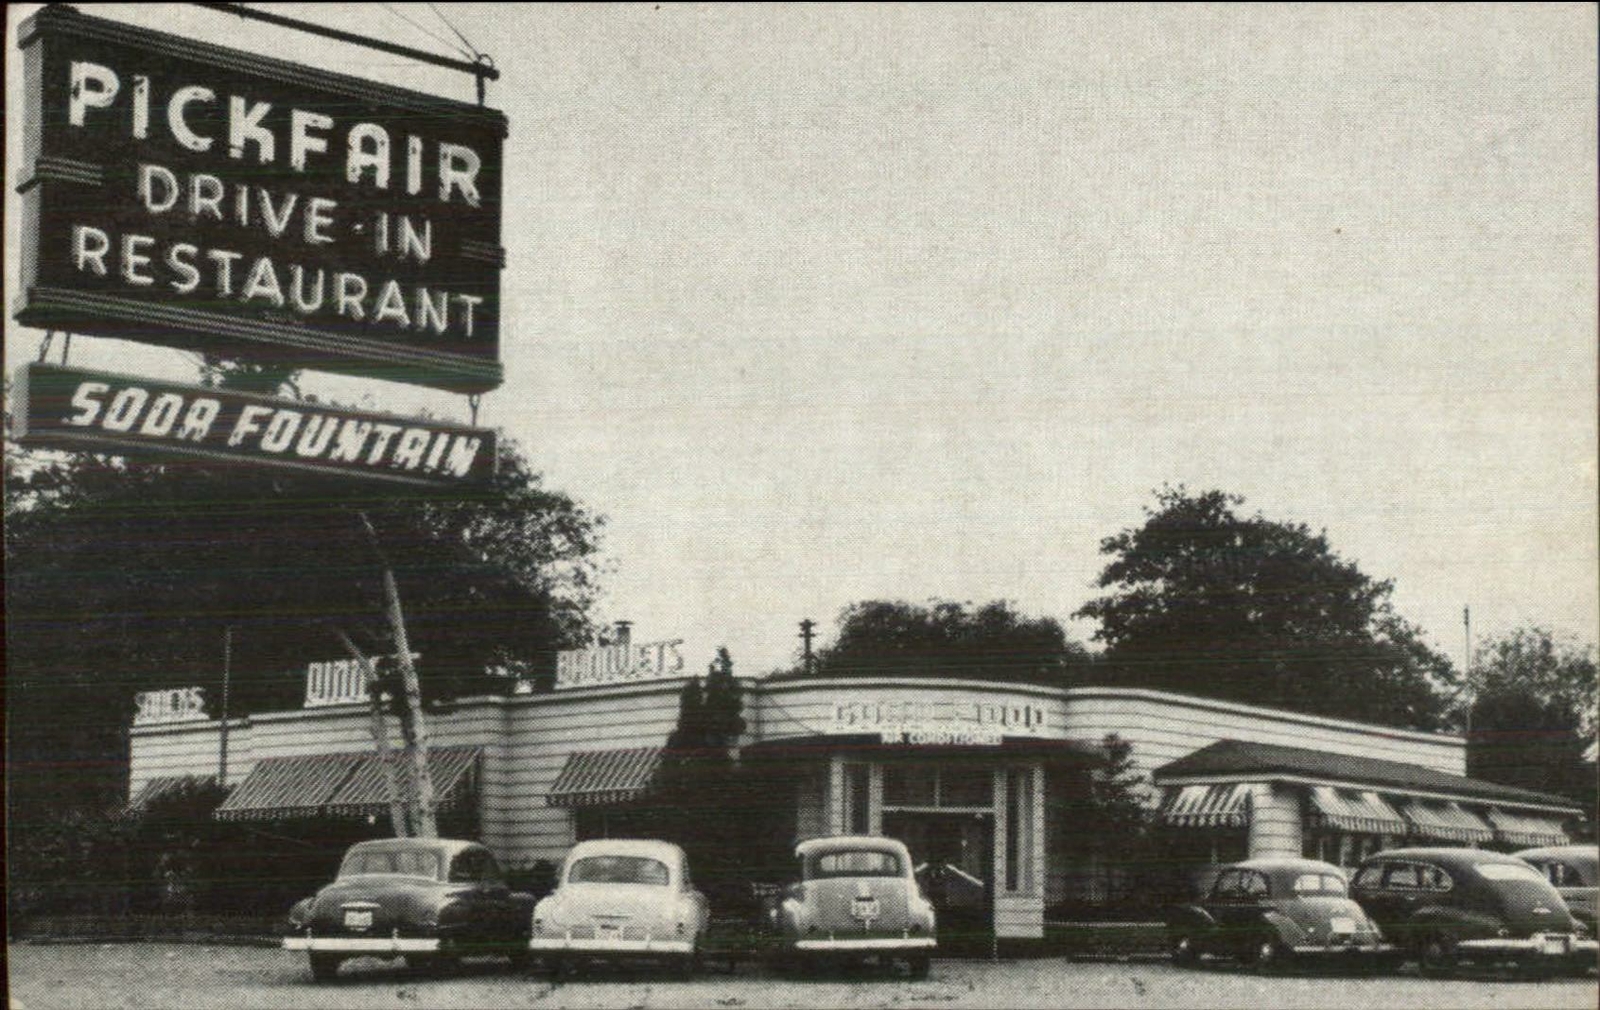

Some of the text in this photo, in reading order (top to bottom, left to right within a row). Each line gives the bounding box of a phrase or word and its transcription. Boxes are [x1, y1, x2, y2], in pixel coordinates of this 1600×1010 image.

[68, 60, 482, 208] PICKFAIR
[72, 225, 483, 338] RESTAURANT
[62, 381, 482, 478] SODA FOUNTAIN
